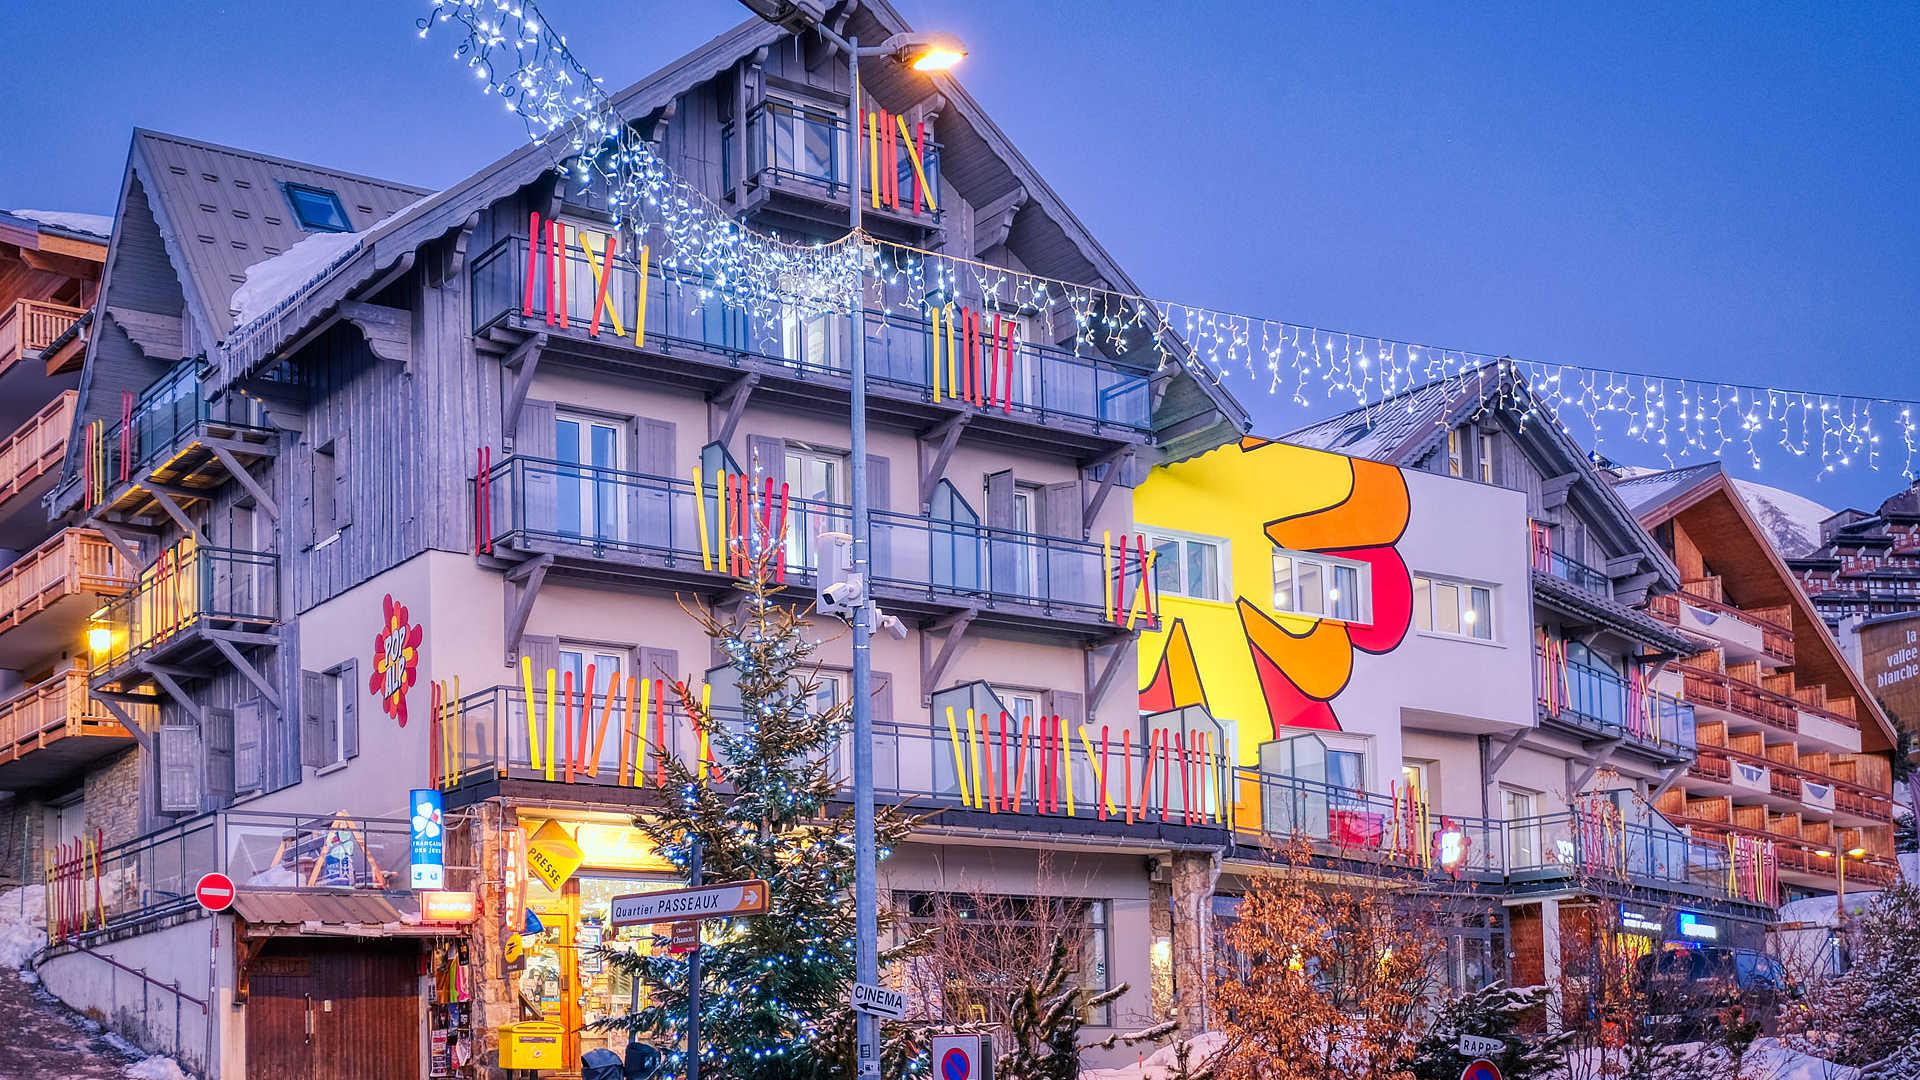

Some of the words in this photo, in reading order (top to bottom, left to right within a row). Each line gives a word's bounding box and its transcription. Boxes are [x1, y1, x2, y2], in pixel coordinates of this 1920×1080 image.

[385, 625, 406, 668] POP
[1906, 630, 1917, 645] la
[384, 655, 406, 700] ALP
[1877, 663, 1919, 689] blanche
[505, 831, 516, 928] TABAC
[528, 847, 561, 884] PRESSE
[615, 905, 654, 918] Quartier
[658, 894, 720, 913] PASSEAUX
[855, 985, 903, 1009] CINEMA
